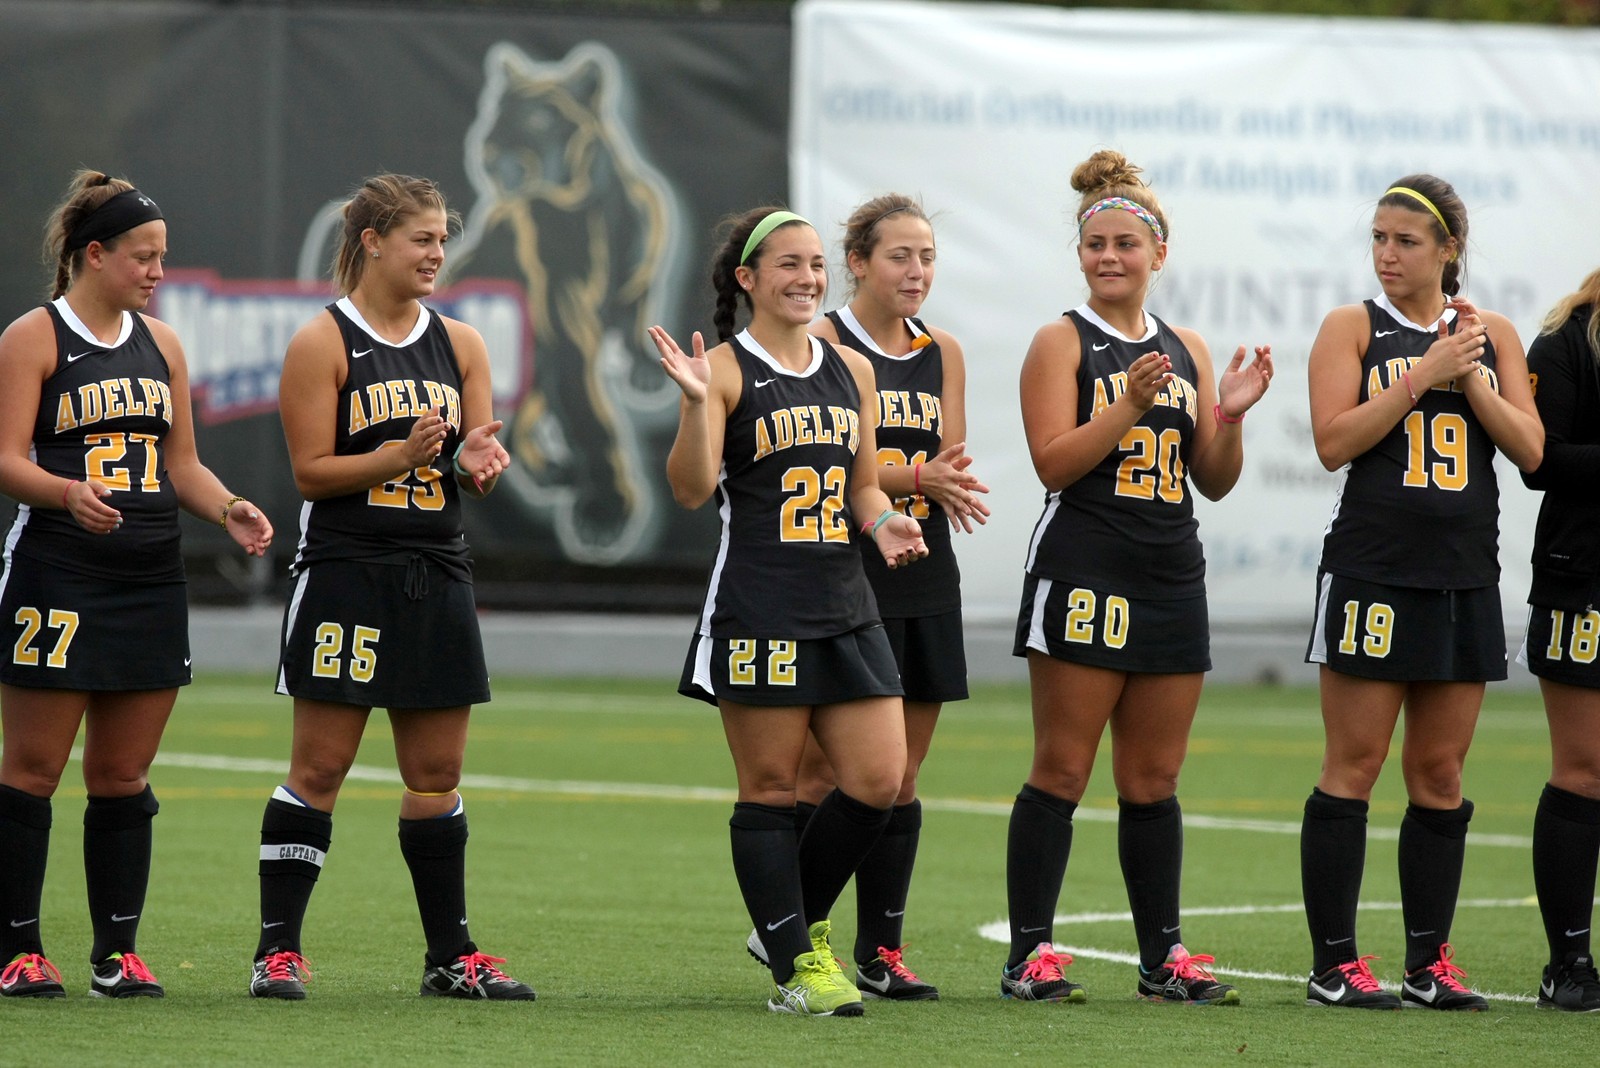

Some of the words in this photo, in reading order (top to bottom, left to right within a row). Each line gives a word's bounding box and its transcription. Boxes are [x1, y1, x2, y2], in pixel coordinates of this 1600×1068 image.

[84, 432, 160, 492] 27
[1115, 426, 1184, 504] 20
[1403, 411, 1468, 491] 19
[780, 466, 850, 544] 22
[13, 606, 79, 668] 27
[1064, 587, 1129, 649] 20
[1339, 600, 1395, 659] 19
[1546, 609, 1600, 664] 18
[312, 621, 381, 683] 25
[729, 639, 797, 686] 22
[279, 846, 319, 863] CAPTAIN
